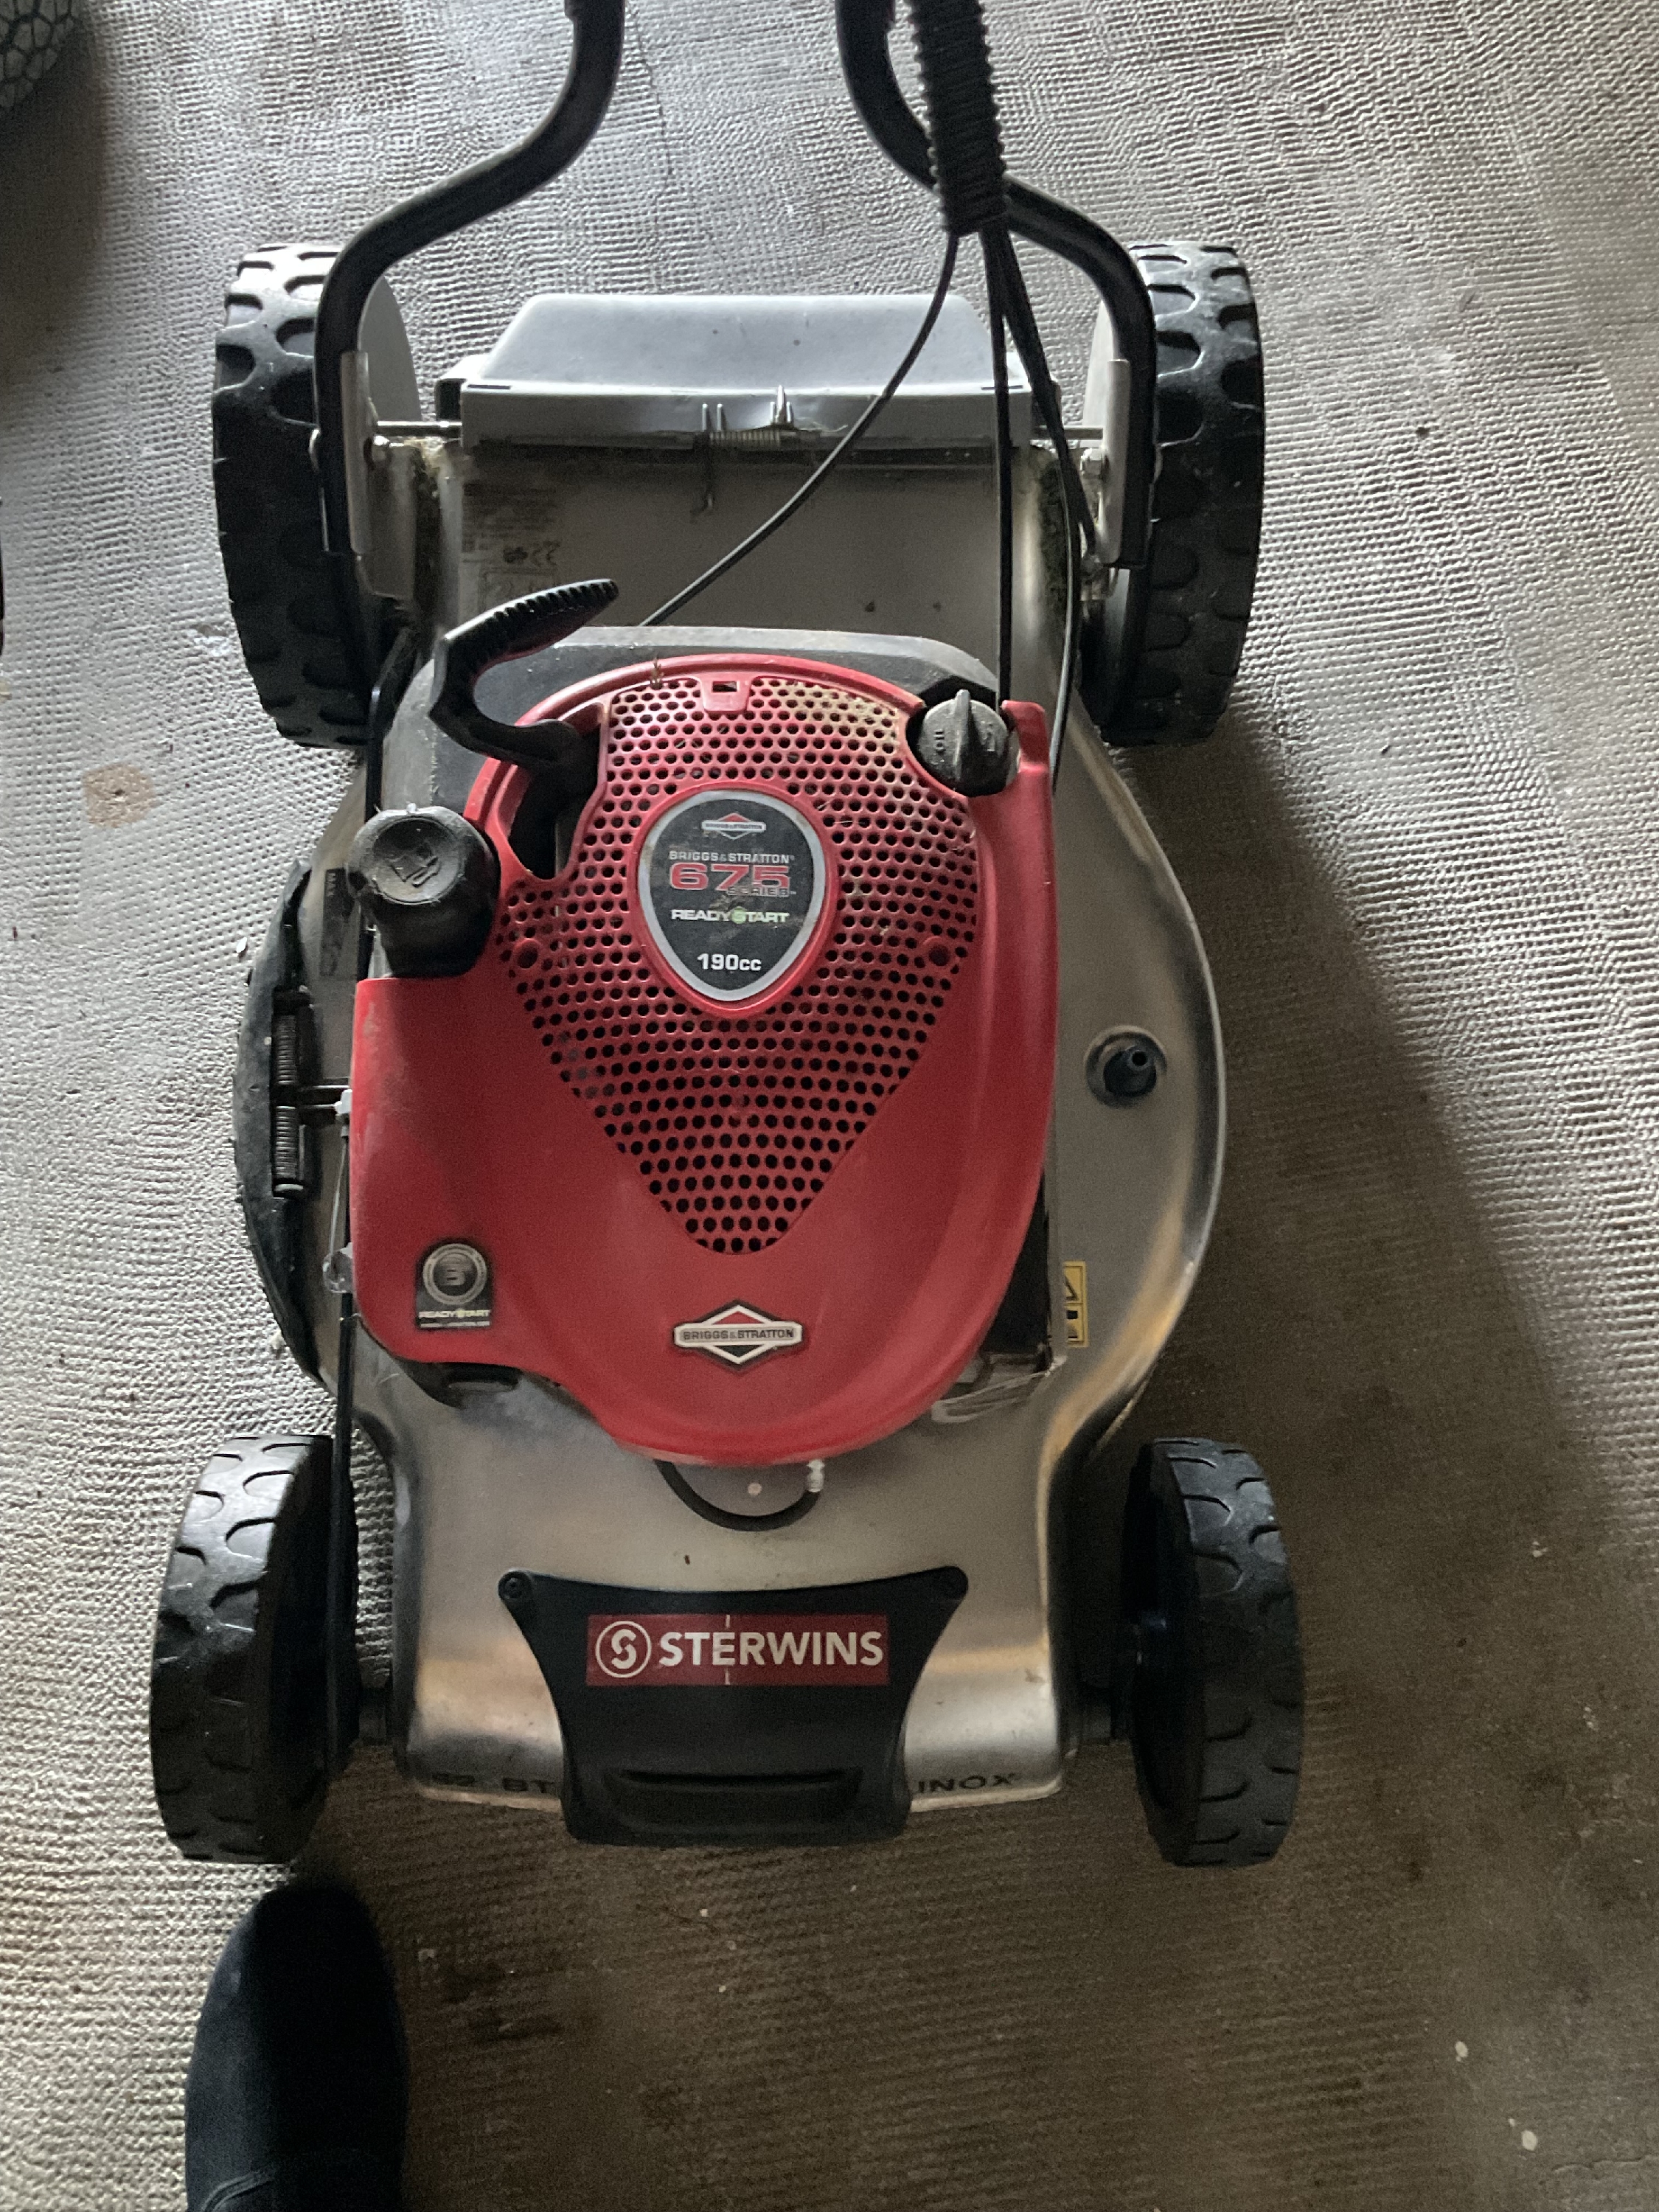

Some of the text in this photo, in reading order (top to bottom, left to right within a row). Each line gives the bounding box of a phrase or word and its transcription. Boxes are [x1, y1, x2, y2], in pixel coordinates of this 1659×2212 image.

[669, 862, 790, 891] 675
[697, 953, 762, 971] 190cc
[658, 1630, 883, 1666] STERWINS
[917, 1773, 1015, 1794] INOX
